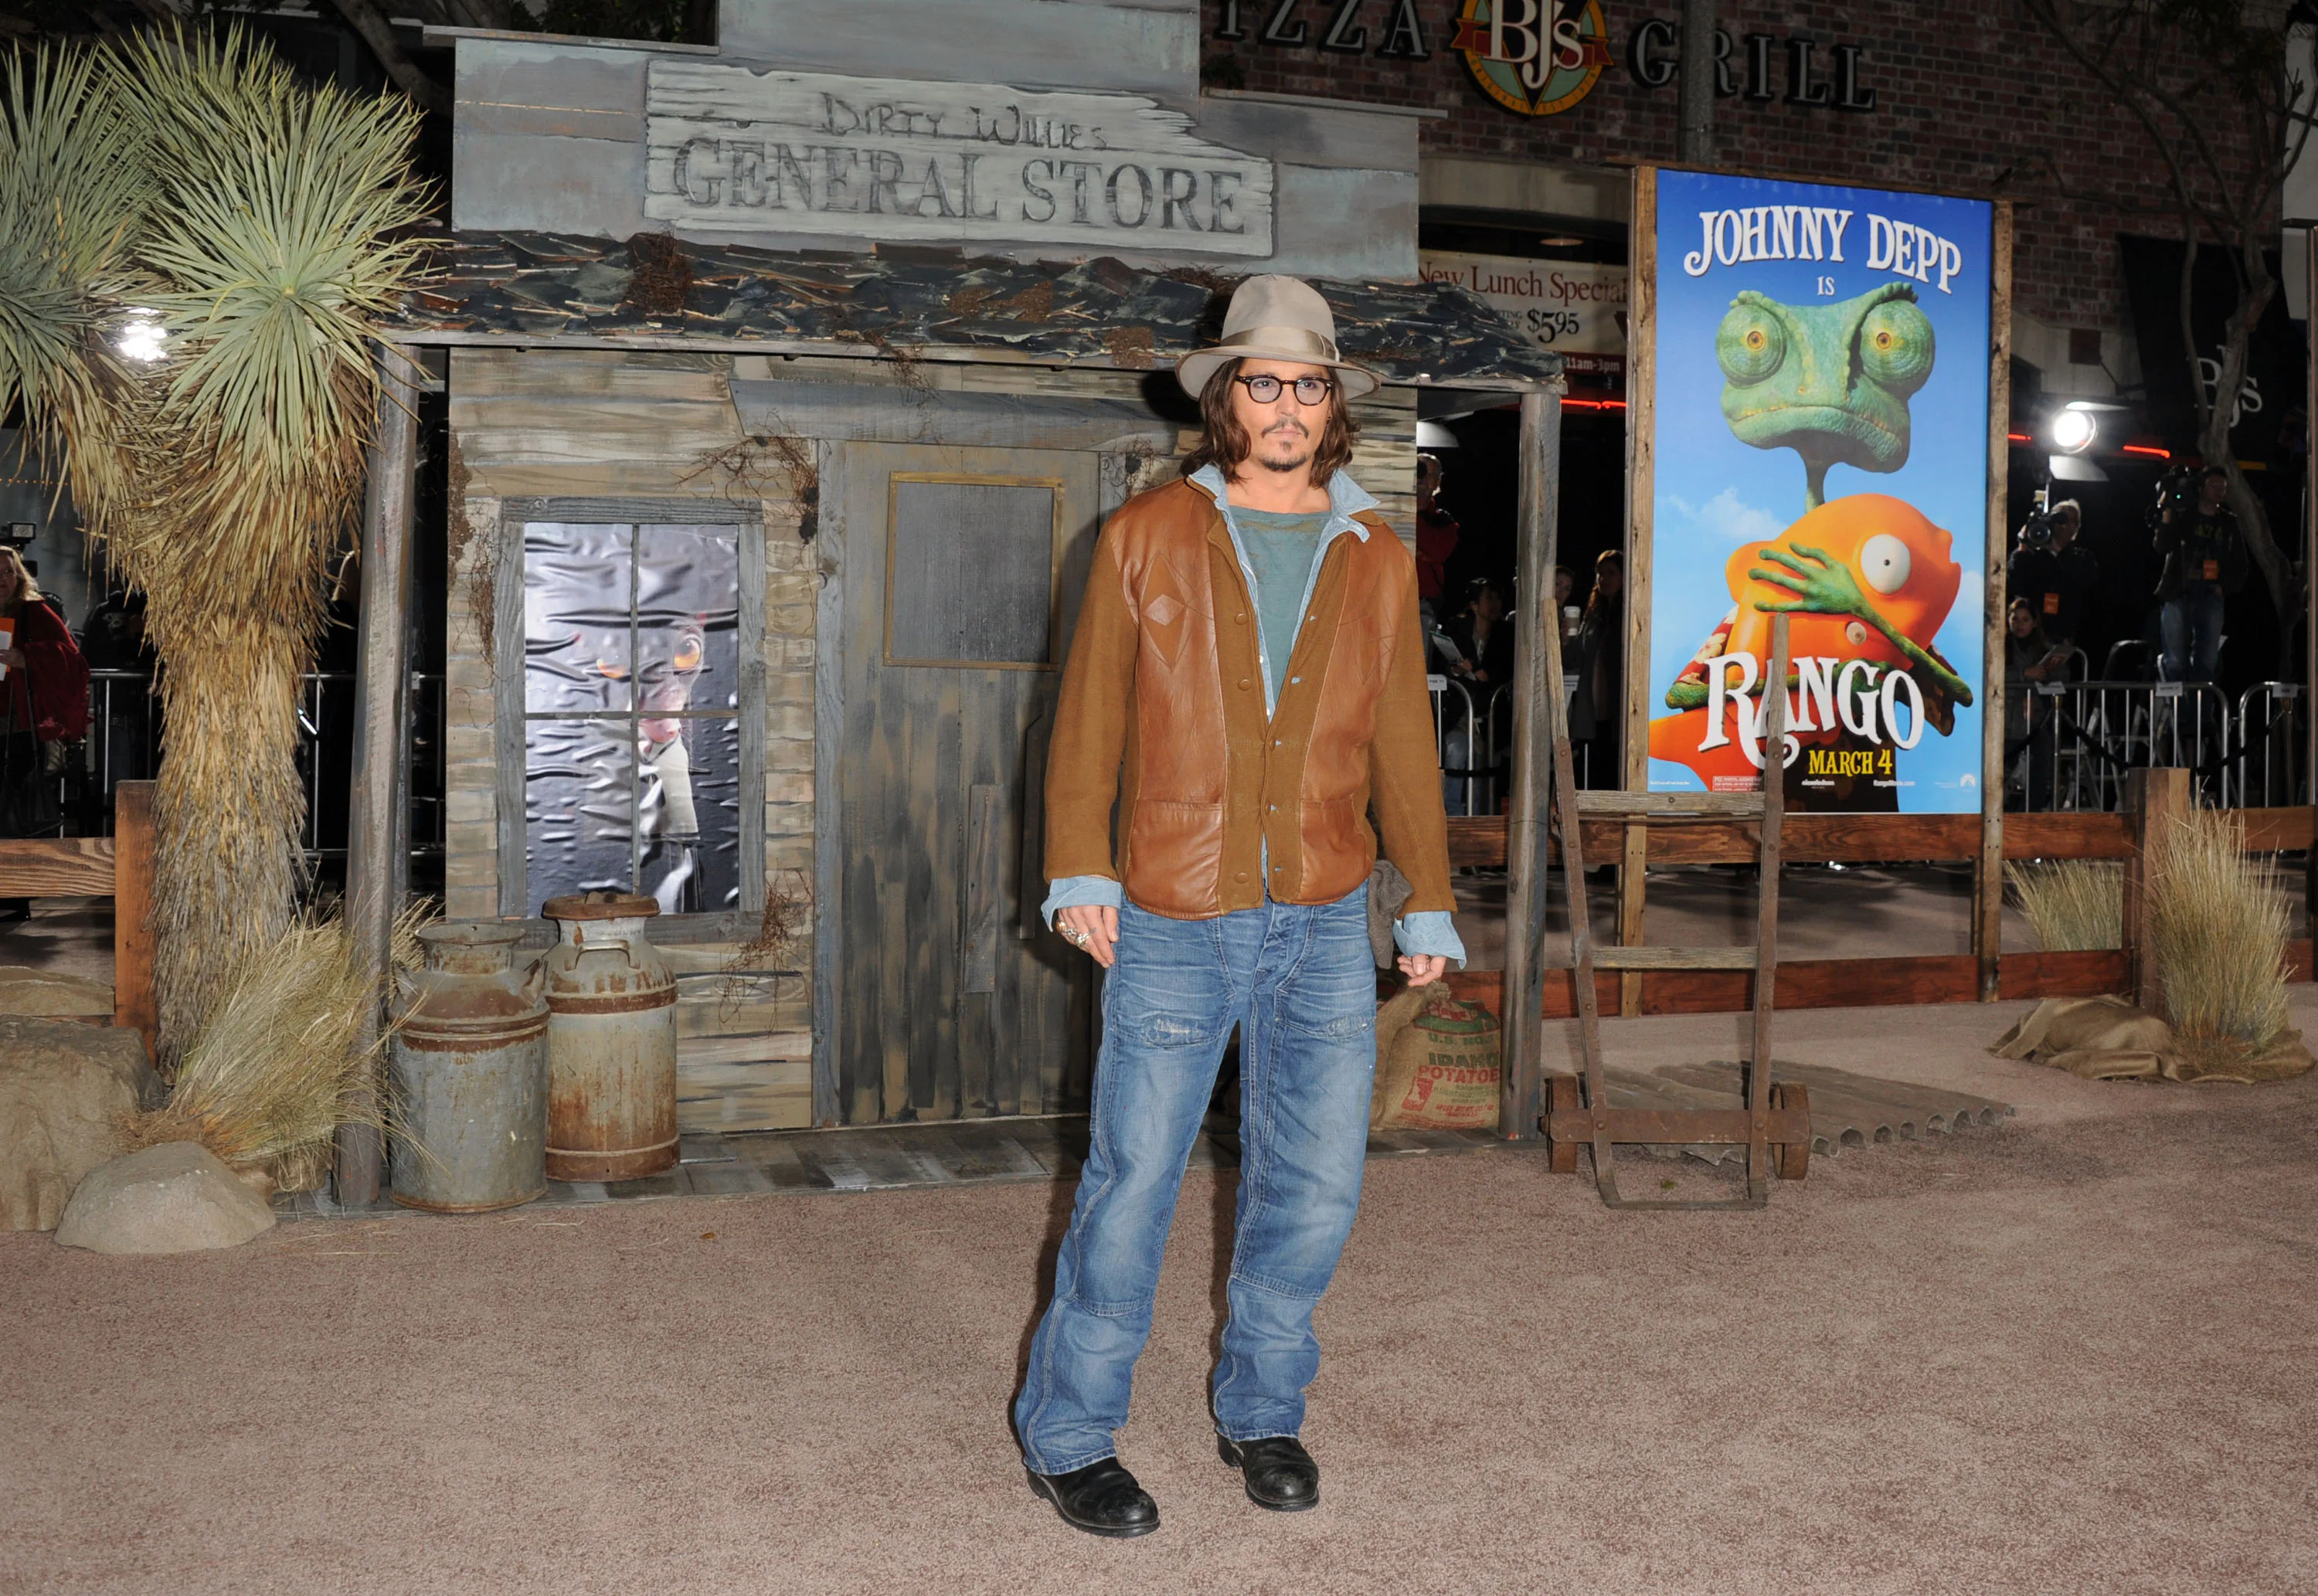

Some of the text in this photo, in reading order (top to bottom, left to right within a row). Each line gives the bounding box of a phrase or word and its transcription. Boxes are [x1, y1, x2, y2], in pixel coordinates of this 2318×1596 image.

[1218, 0, 1429, 58] IZZA
[1479, 0, 1585, 90] BJ's
[672, 137, 1248, 235] GENERAL STORE
[1684, 205, 1962, 295] JOHNNY DEPP
[1470, 266, 1542, 297] Lunch
[1817, 275, 1836, 297] IS
[1565, 356, 1620, 375] 11am-3pm
[1698, 651, 1925, 770] RANGO
[1808, 749, 1893, 777] MARCH 4
[1417, 1065, 1500, 1083] POTATOE
[1429, 1051, 1499, 1068] IDAHO
